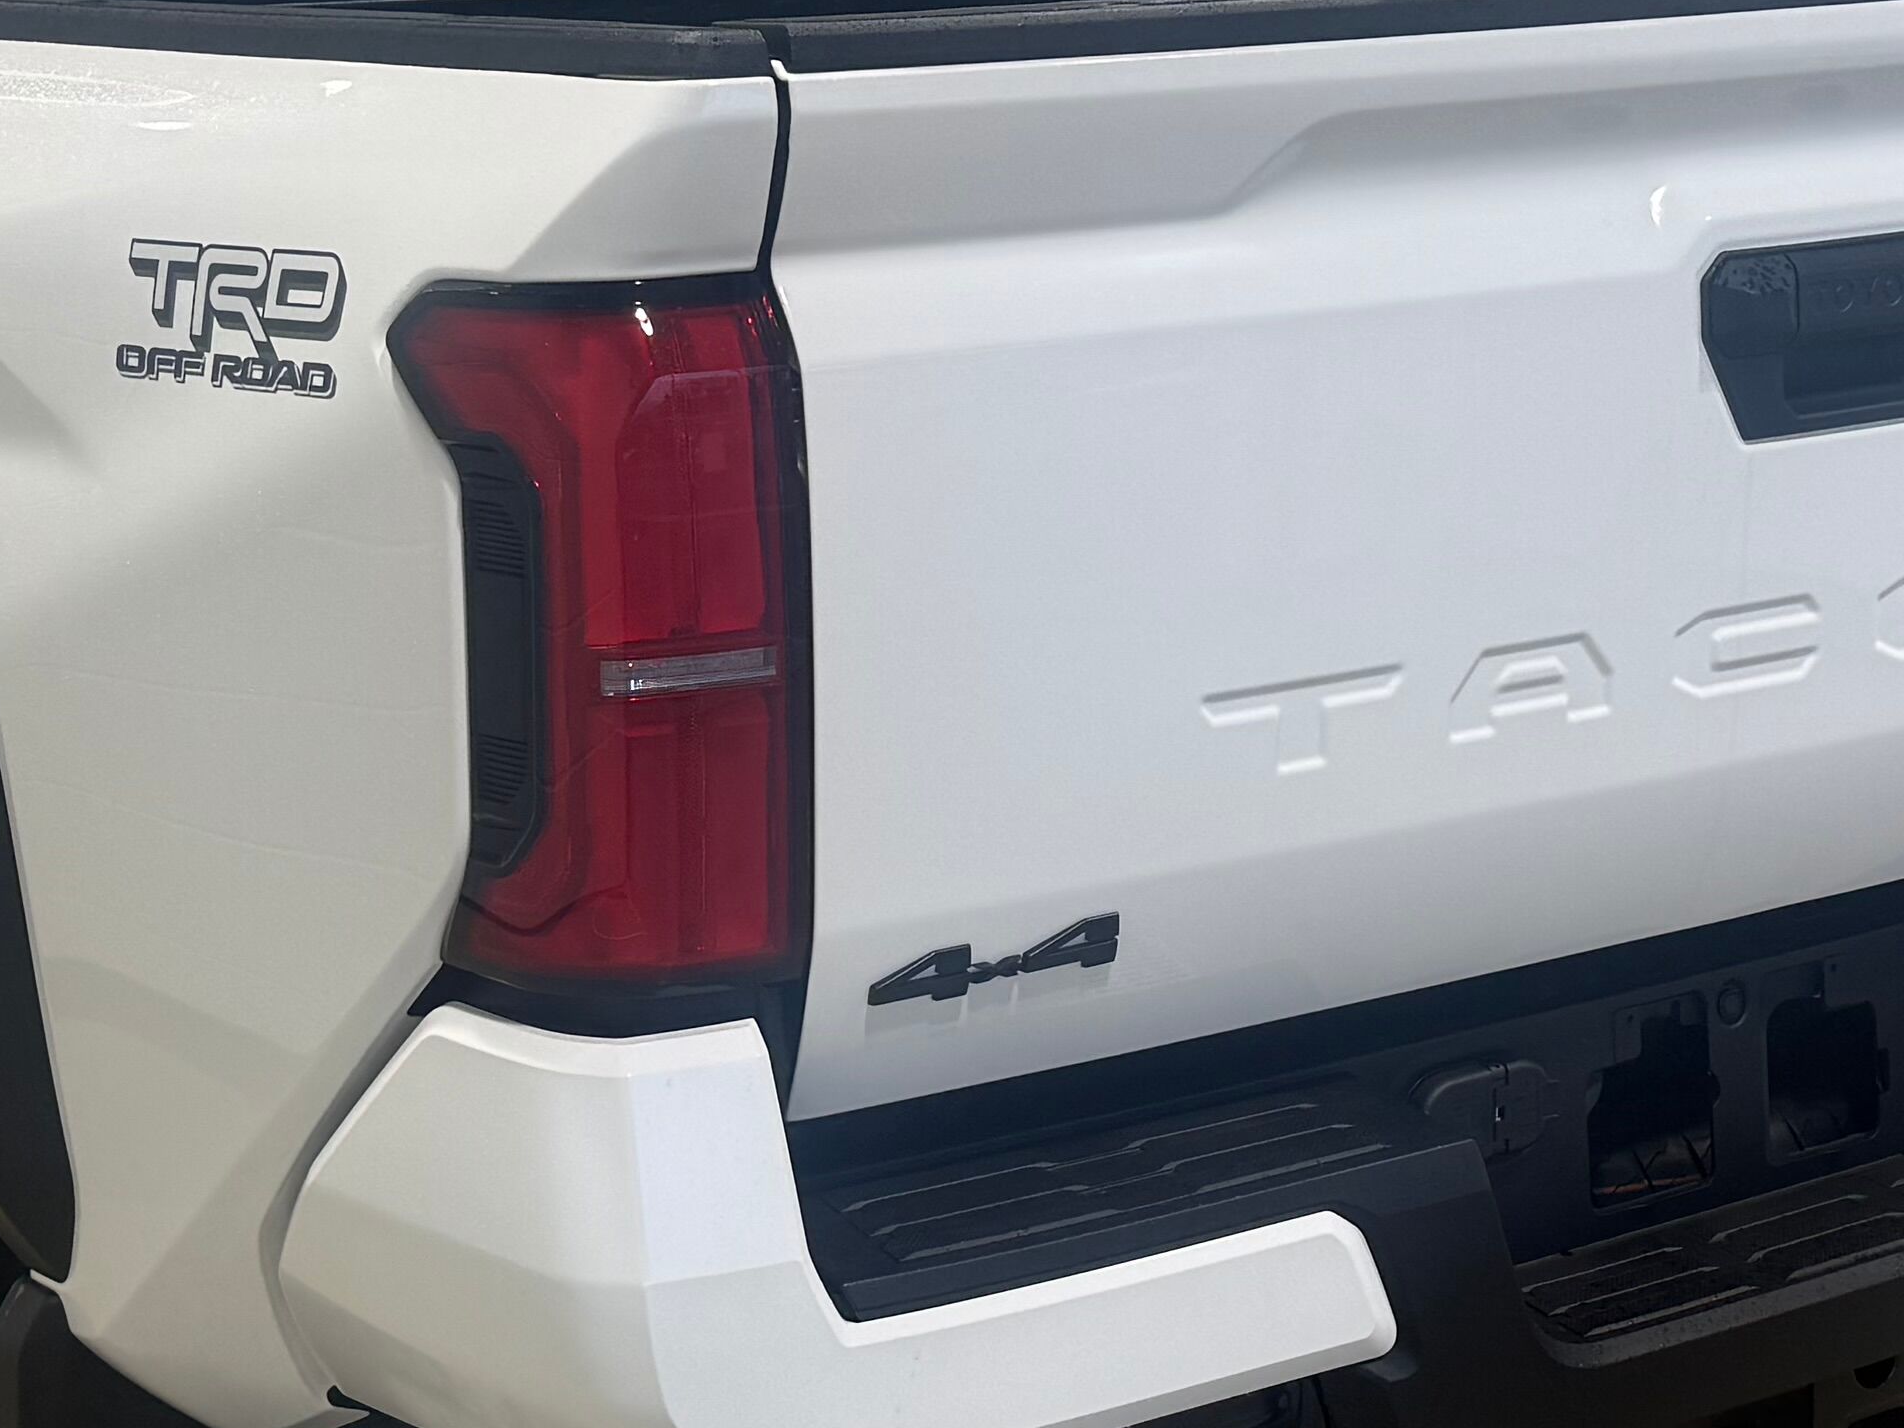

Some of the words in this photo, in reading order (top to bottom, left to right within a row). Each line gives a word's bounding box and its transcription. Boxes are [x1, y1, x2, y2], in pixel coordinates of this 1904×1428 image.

[129, 238, 347, 362] TRD
[116, 344, 206, 383] OFF
[211, 353, 337, 399] ROAD
